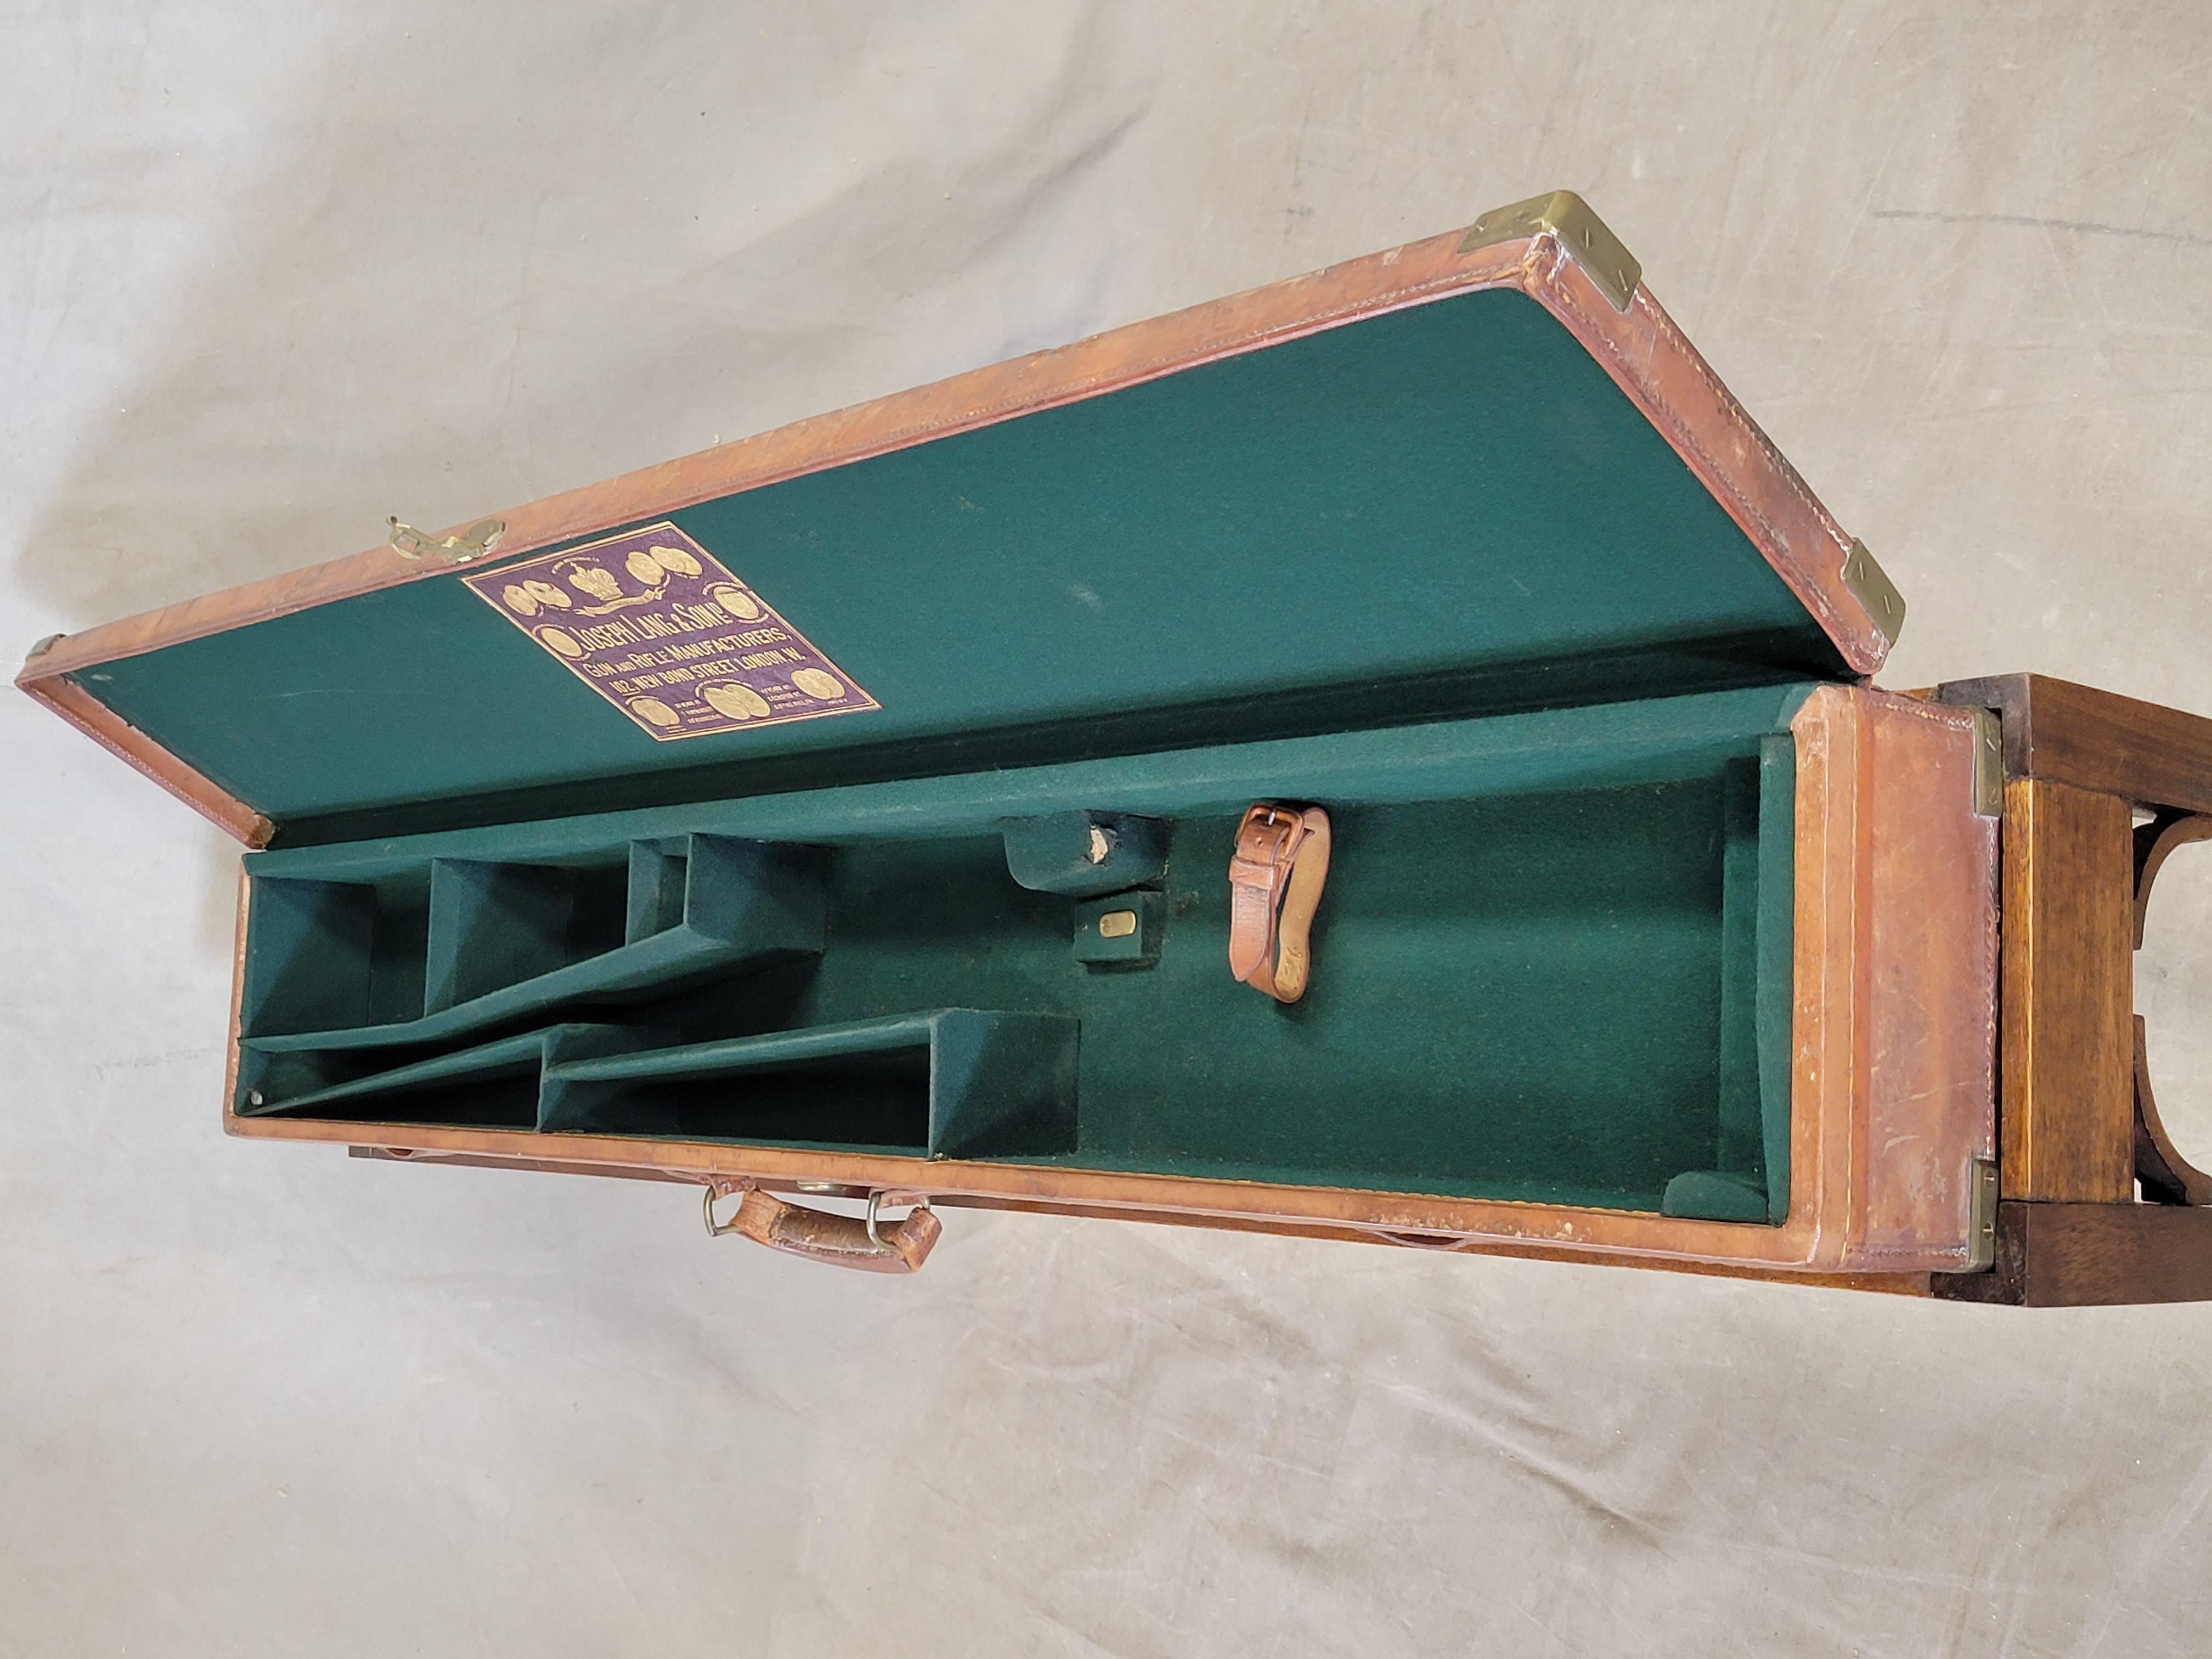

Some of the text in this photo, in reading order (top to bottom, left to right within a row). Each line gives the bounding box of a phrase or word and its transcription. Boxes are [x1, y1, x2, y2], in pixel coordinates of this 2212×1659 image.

[568, 621, 641, 652] JOSEPH
[620, 613, 681, 640] LANG
[670, 613, 695, 631] &
[583, 627, 793, 678] GUN AND RIFLE MANUFACTURERS,
[631, 674, 664, 690] NEW
[657, 668, 695, 684] BOND
[690, 659, 739, 678] STREET
